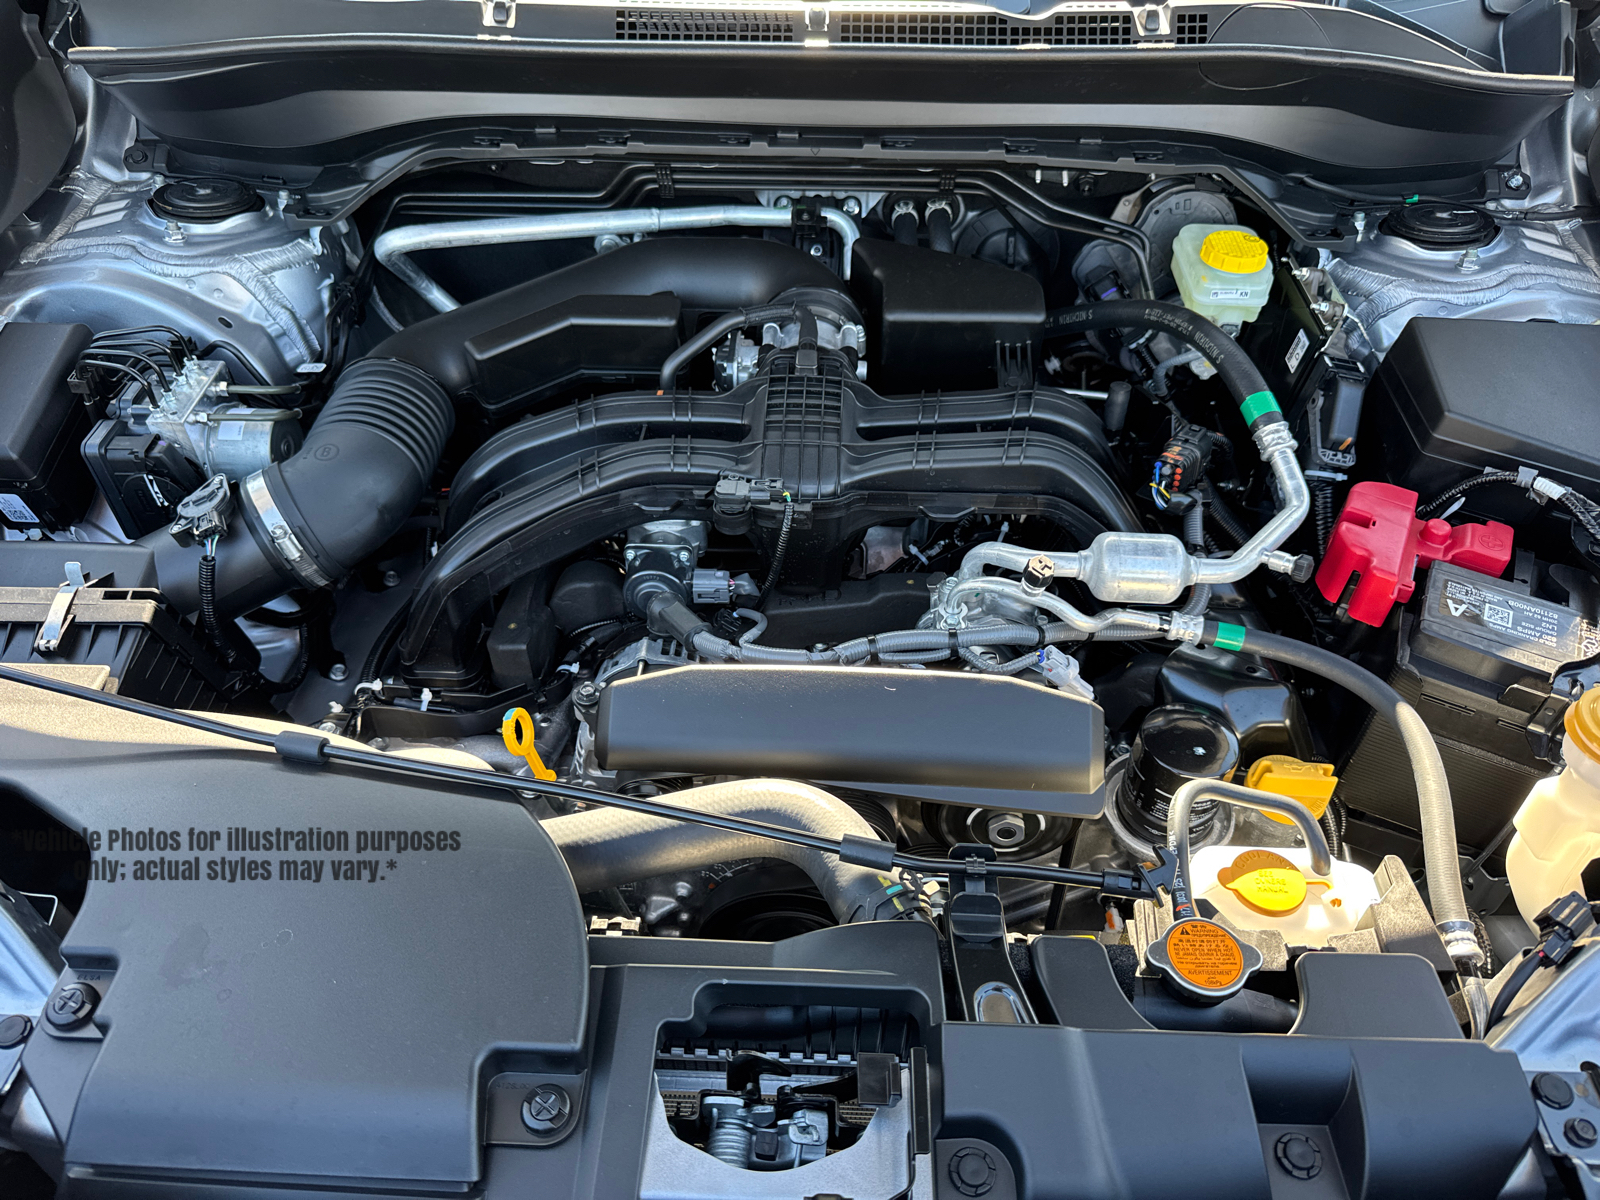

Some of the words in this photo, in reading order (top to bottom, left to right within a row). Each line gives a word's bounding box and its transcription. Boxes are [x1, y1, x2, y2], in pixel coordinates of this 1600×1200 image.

[1516, 626, 1541, 637] AMPS
[1535, 627, 1557, 636] GROUP
[1542, 622, 1557, 631] LN2
[1507, 629, 1538, 642] CRANKING
[1539, 638, 1557, 648] COLD
